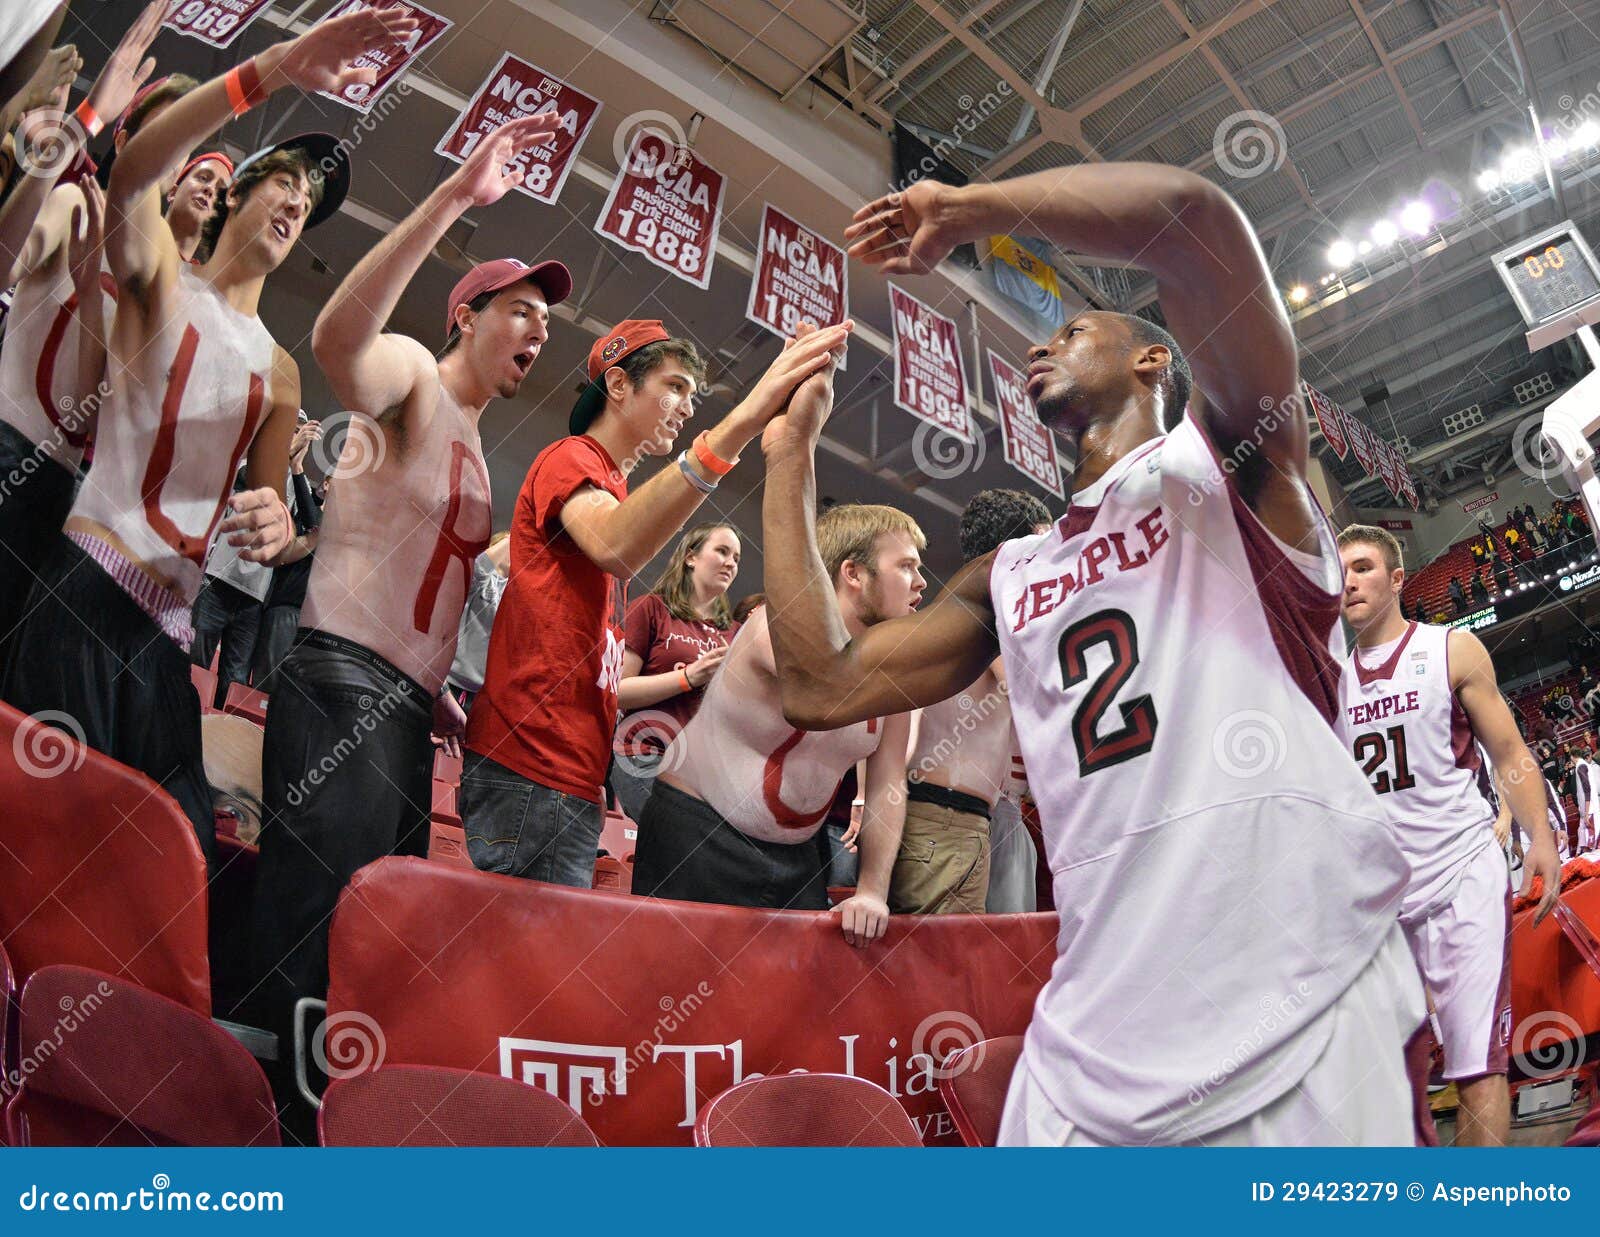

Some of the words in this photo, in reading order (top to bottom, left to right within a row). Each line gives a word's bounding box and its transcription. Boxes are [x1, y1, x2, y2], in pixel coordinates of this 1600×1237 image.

[632, 148, 709, 213] NCAA
[633, 186, 702, 231] BASKETBALL
[618, 208, 701, 273] 1988
[630, 198, 663, 224] ELITE
[662, 217, 699, 243] EIGHT
[767, 227, 839, 294] NCAA
[772, 266, 834, 313] BASKETBALL
[772, 281, 801, 306] ELITE
[802, 298, 832, 324] EIGHT
[896, 308, 957, 370] NCAA
[905, 376, 966, 431] 1993
[996, 374, 1039, 420] NCA
[1008, 437, 1058, 488] 1999
[1012, 506, 1171, 634] TEMPLE
[1058, 608, 1159, 778] 2
[1353, 724, 1416, 795] 21
